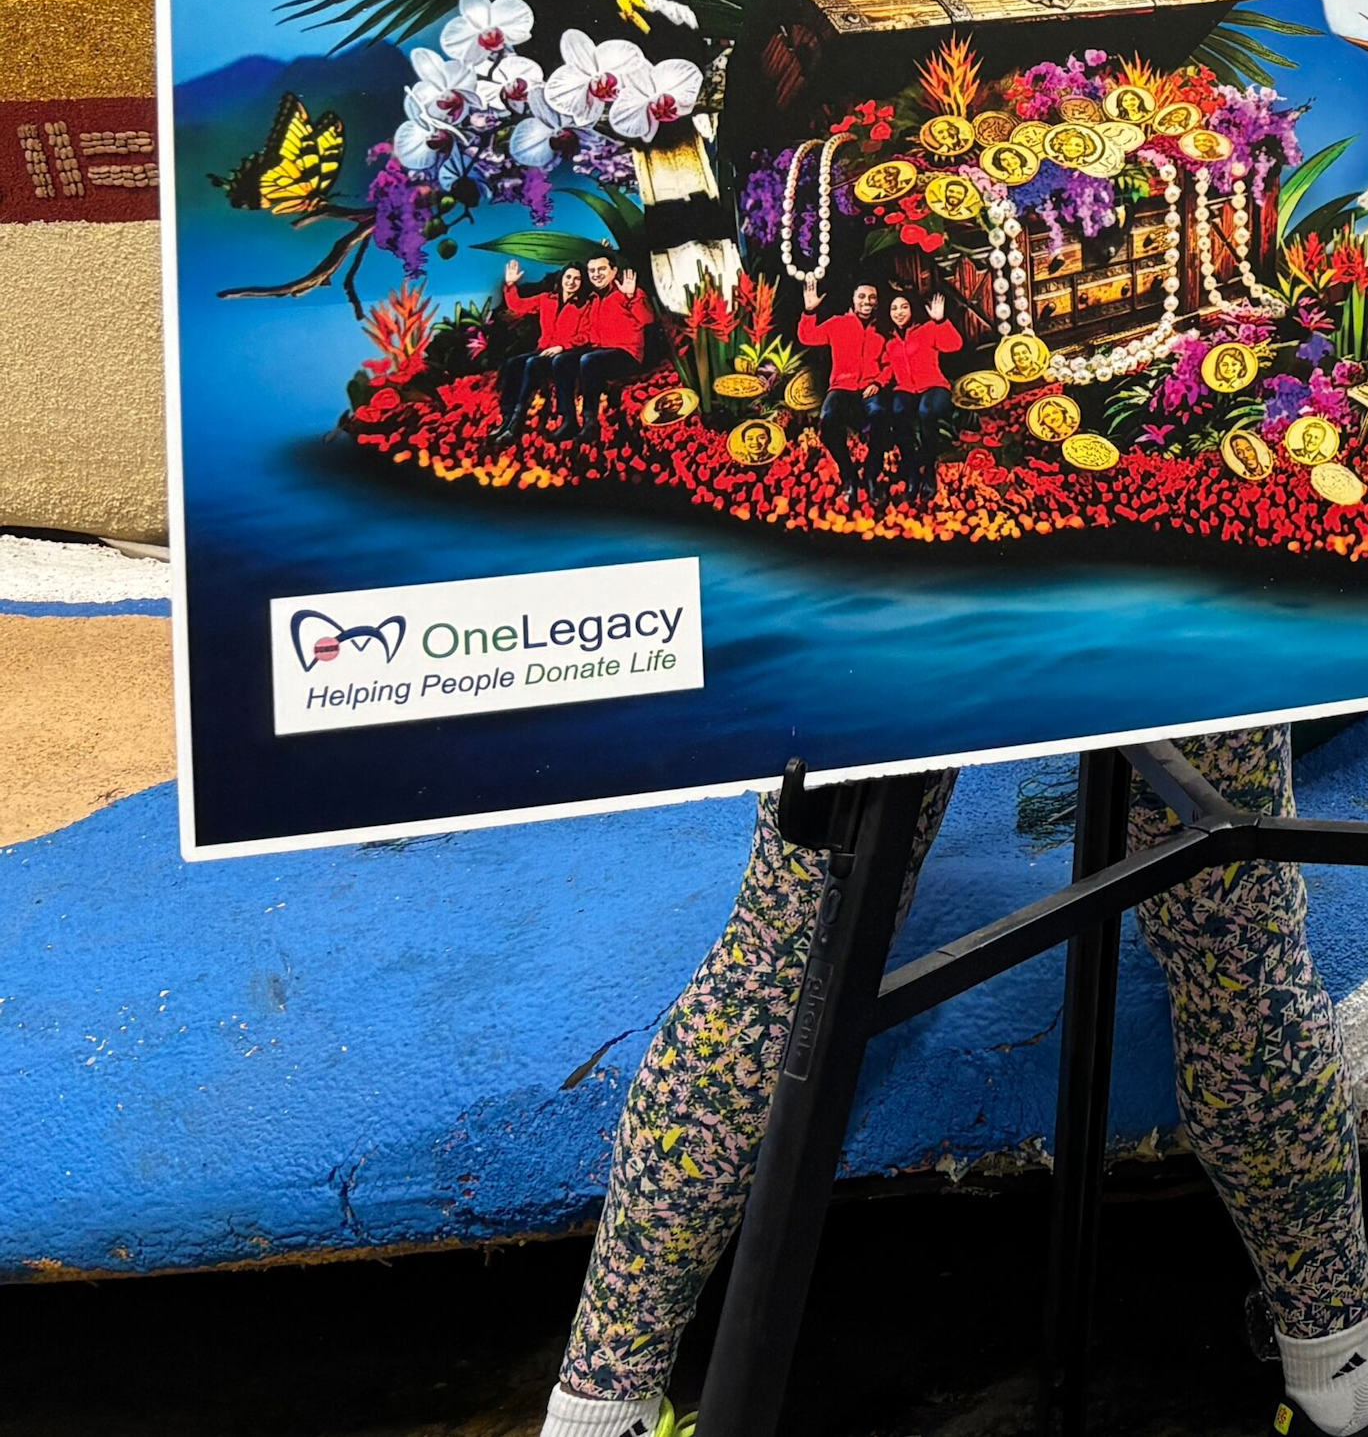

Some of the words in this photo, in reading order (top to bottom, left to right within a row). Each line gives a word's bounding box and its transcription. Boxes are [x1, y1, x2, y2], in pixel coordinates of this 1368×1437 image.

[421, 606, 684, 660] OneLegacy
[305, 678, 412, 710] Helping
[420, 667, 515, 697] People
[524, 655, 621, 686] Donate
[630, 649, 678, 674] Life
